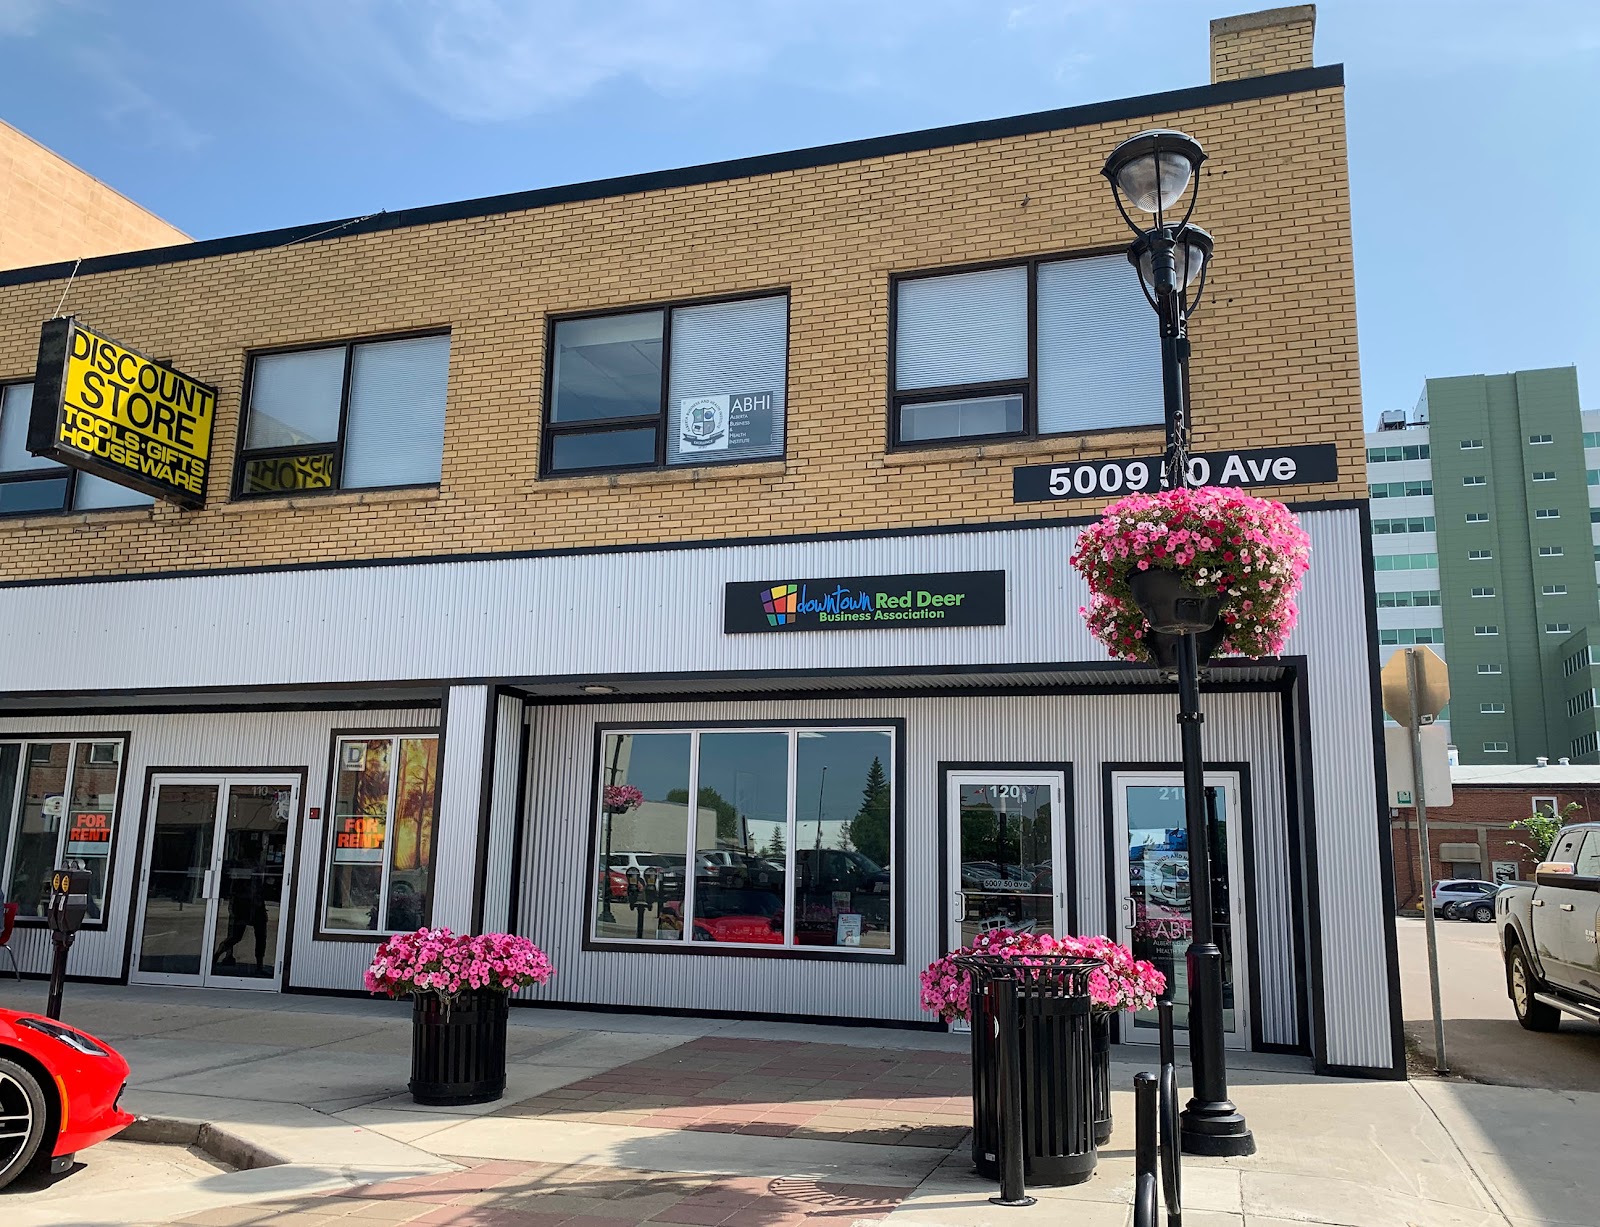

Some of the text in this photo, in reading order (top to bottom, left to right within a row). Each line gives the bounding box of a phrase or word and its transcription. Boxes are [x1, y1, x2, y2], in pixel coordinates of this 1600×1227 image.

[71, 329, 213, 417] DISCOUNT
[80, 371, 197, 450] STORE
[731, 394, 770, 413] ABHI
[59, 423, 203, 494] HOUSEWARE
[1049, 465, 1149, 496] 5009
[1220, 455, 1297, 485] Ave
[796, 584, 965, 615] downtown Red Deer
[819, 608, 945, 623] Business Association
[989, 785, 1021, 798] 120
[77, 814, 107, 828] FOR
[344, 818, 379, 833] FOR
[70, 828, 111, 841] RENT
[337, 833, 384, 848] RENT
[1154, 920, 1193, 940] ABH
